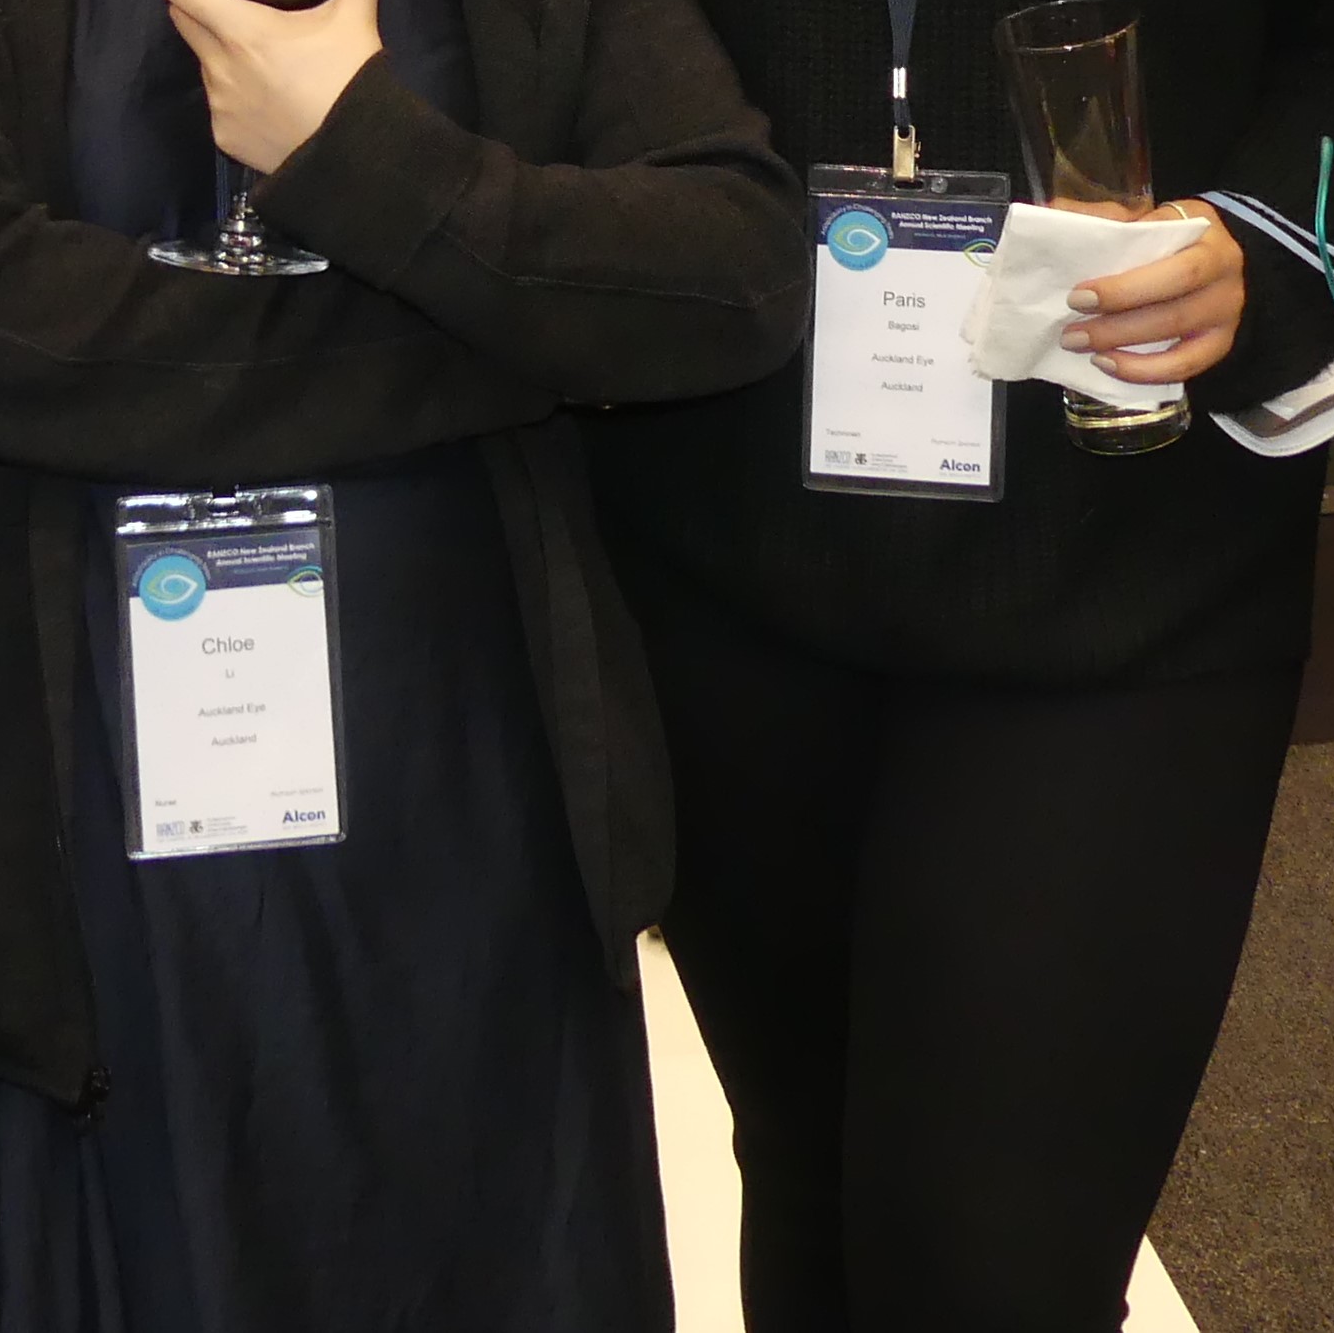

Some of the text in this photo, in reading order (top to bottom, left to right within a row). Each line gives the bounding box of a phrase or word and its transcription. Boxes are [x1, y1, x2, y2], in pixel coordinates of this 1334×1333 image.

[882, 290, 926, 309] Paris
[939, 458, 981, 473] Alcon
[201, 634, 255, 655] Chloe
[282, 809, 326, 824] Alcon
